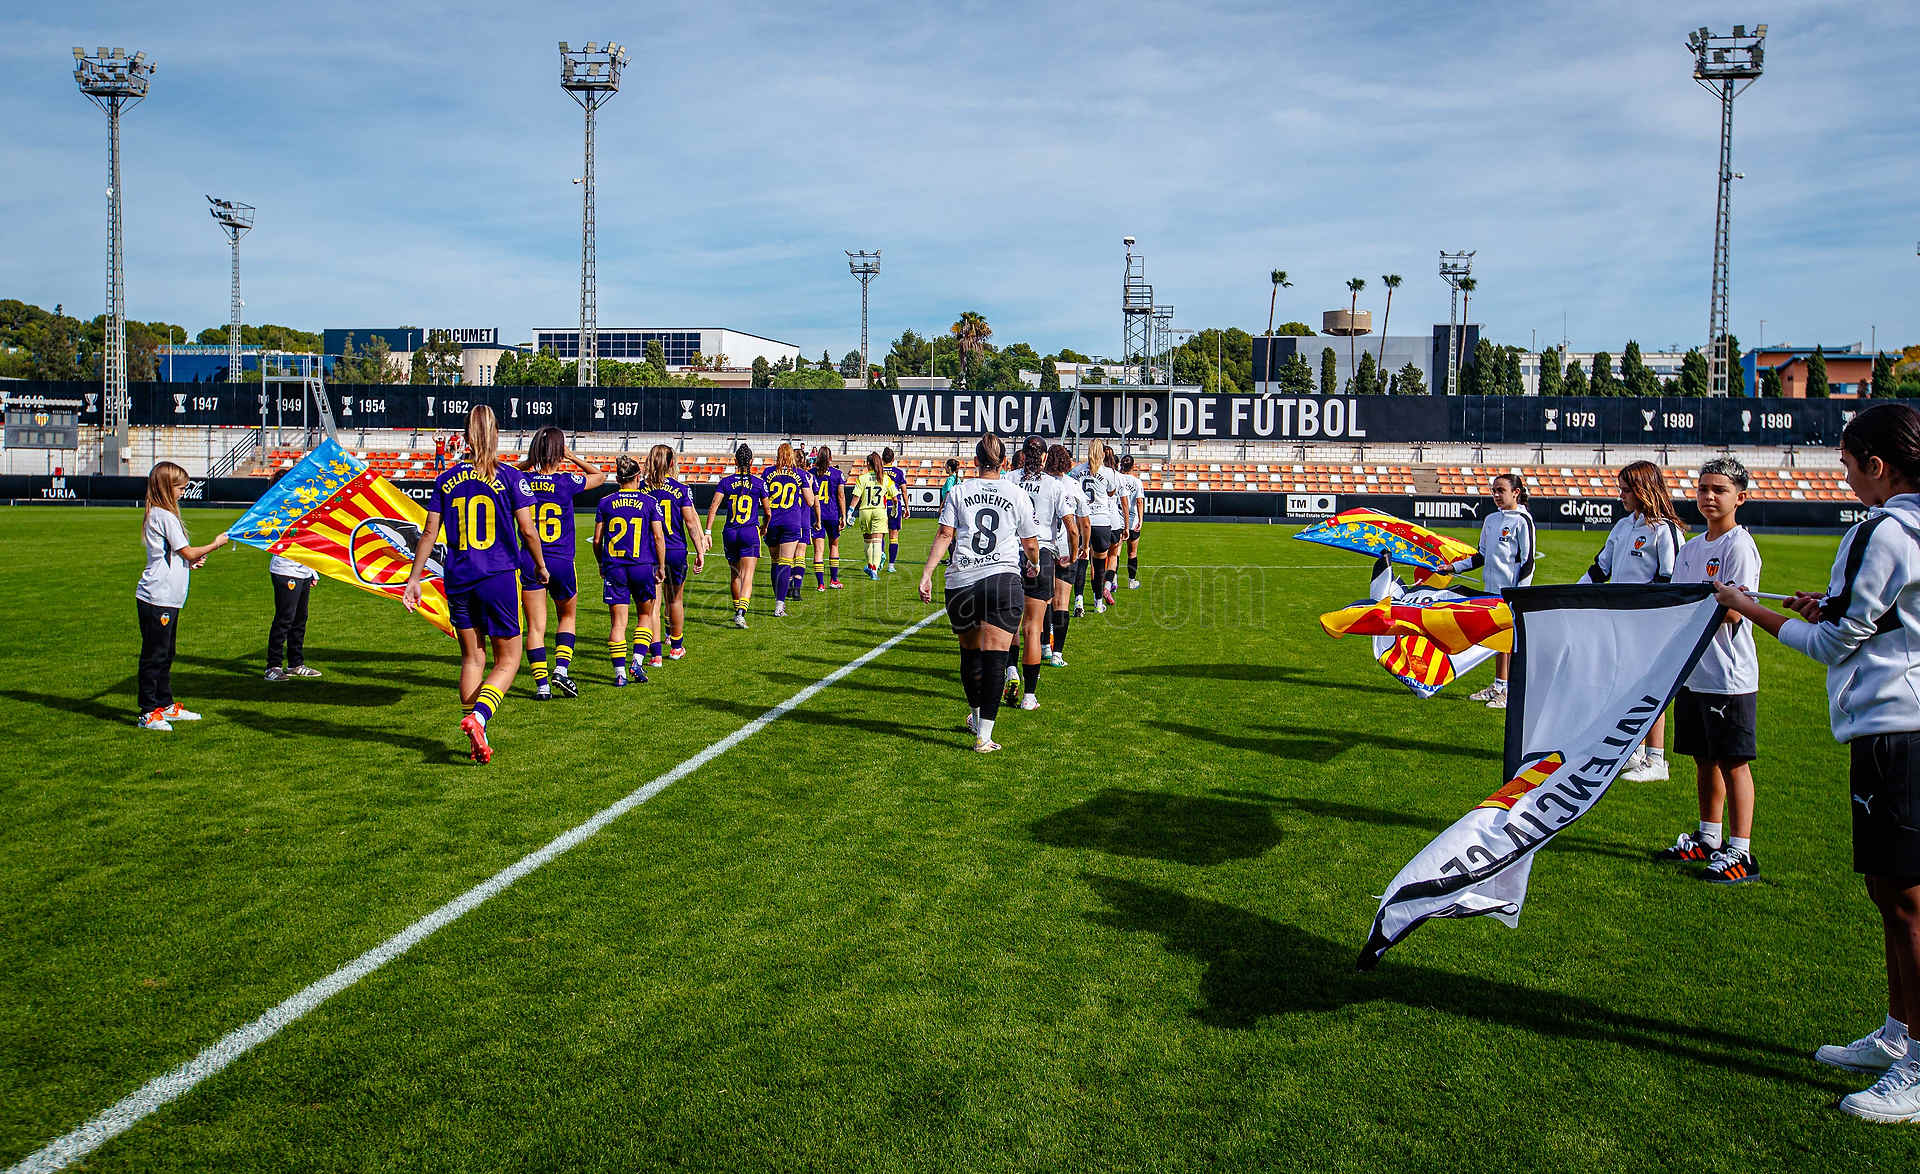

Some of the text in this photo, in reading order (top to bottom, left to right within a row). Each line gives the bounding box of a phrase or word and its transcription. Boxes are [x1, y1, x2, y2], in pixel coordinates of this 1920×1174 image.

[192, 396, 218, 411] 1947
[275, 399, 302, 412] 1949
[359, 399, 386, 413] 1954
[442, 400, 469, 414] 1962
[526, 401, 553, 415] 1963
[612, 402, 639, 416] 1967
[699, 403, 726, 417] 1971
[891, 392, 1367, 438] VALENCIA CLUB DE FÚTBOL
[1565, 412, 1596, 427] 1979
[1662, 412, 1694, 428] 1980
[1760, 413, 1792, 429] 1980
[441, 470, 469, 494] CELIA
[530, 481, 555, 493] ELISA
[41, 488, 76, 499] TURIA
[769, 481, 797, 509] 20
[865, 486, 882, 506] 13
[1082, 478, 1095, 504] 5
[612, 498, 643, 511] MIREYA
[729, 494, 753, 525] 19
[964, 493, 1013, 512] MONENTE
[1290, 499, 1307, 509] TM
[1560, 499, 1613, 516] divina
[451, 495, 496, 551] 10
[1584, 516, 1611, 524] seguros
[608, 517, 643, 558] 21
[971, 507, 1000, 556] 8
[974, 552, 1001, 565] MSC
